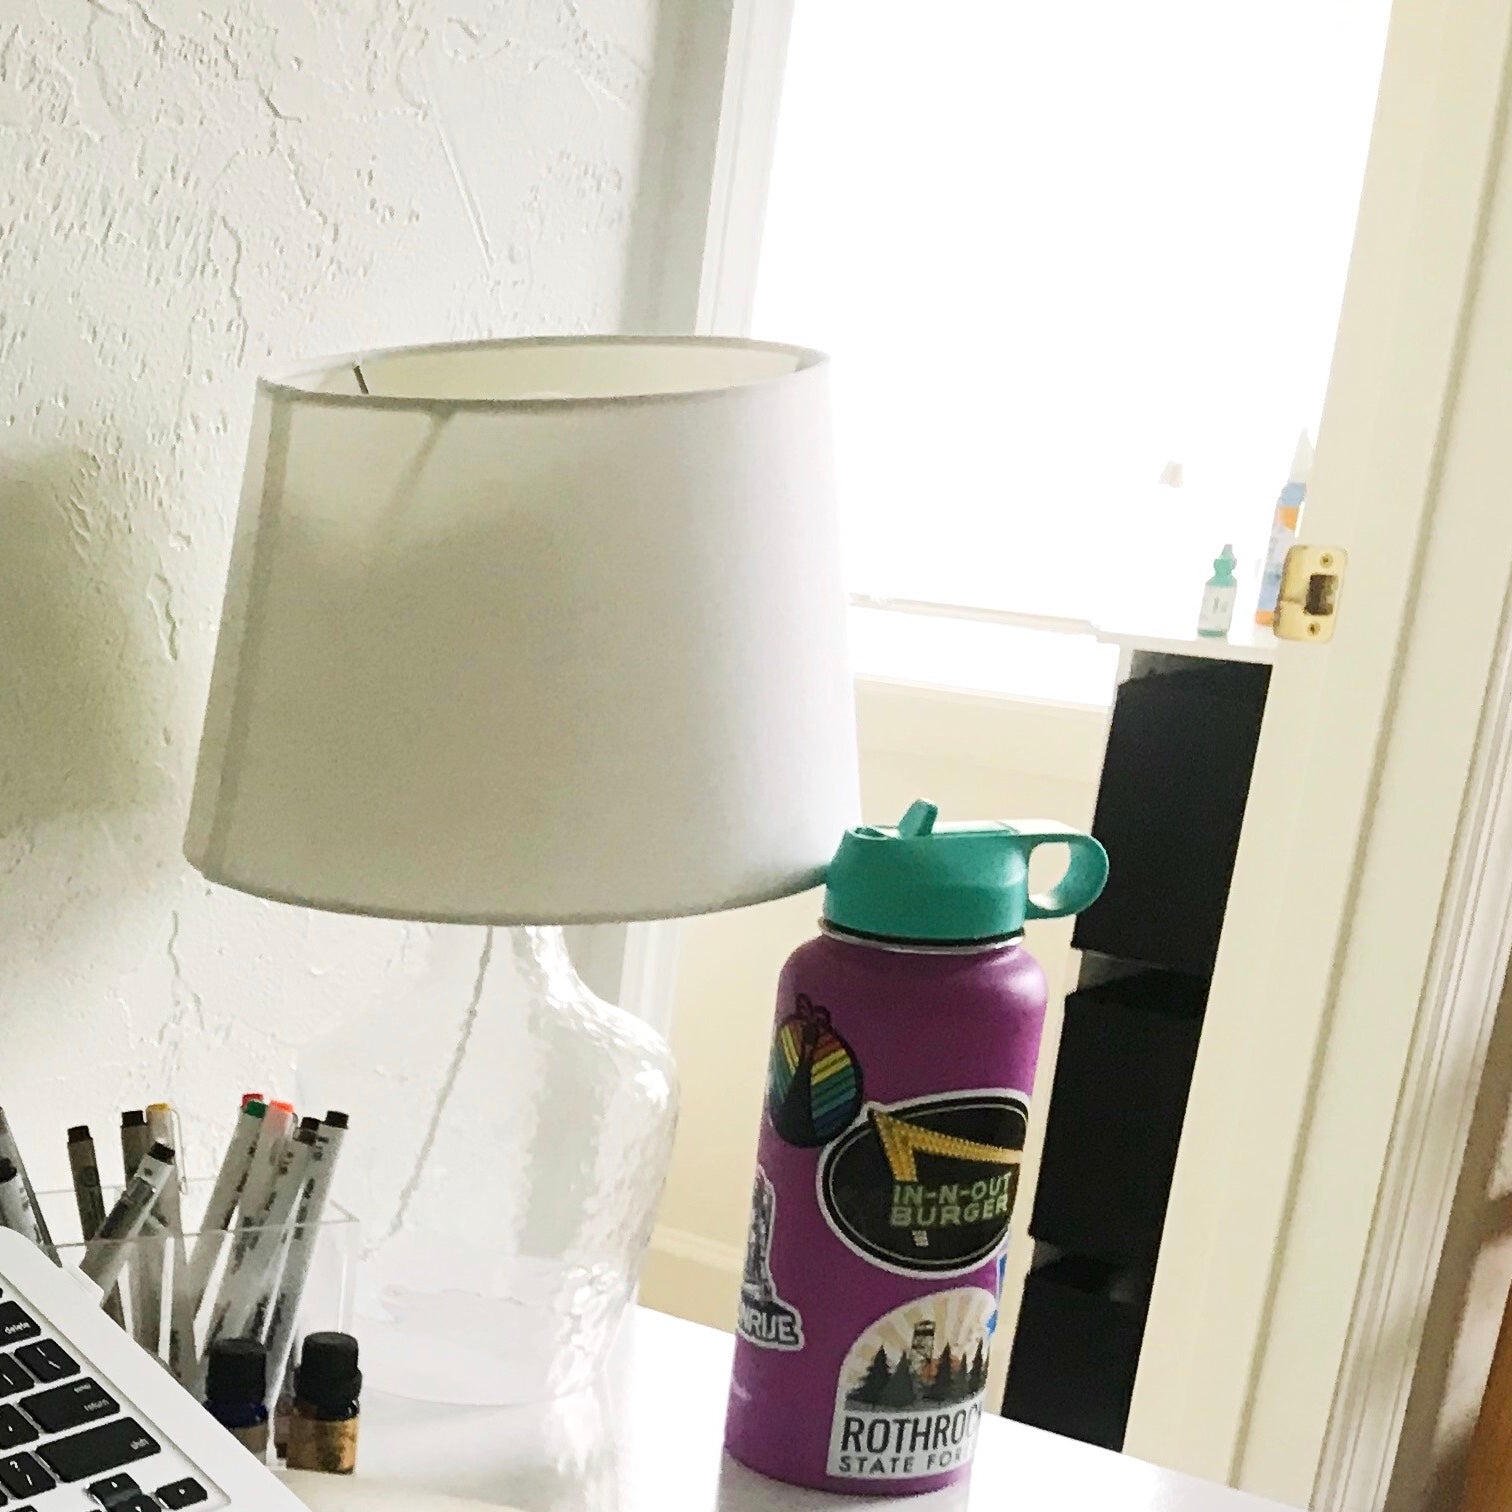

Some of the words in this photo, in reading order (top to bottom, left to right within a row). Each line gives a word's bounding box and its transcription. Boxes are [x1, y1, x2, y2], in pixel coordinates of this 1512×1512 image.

[892, 1171, 1012, 1205] IN-N-OUT
[889, 1194, 1008, 1227] BURGER
[5, 1323, 30, 1334] delete
[841, 1402, 982, 1454] ROTHROC
[838, 1455, 914, 1475] STATE
